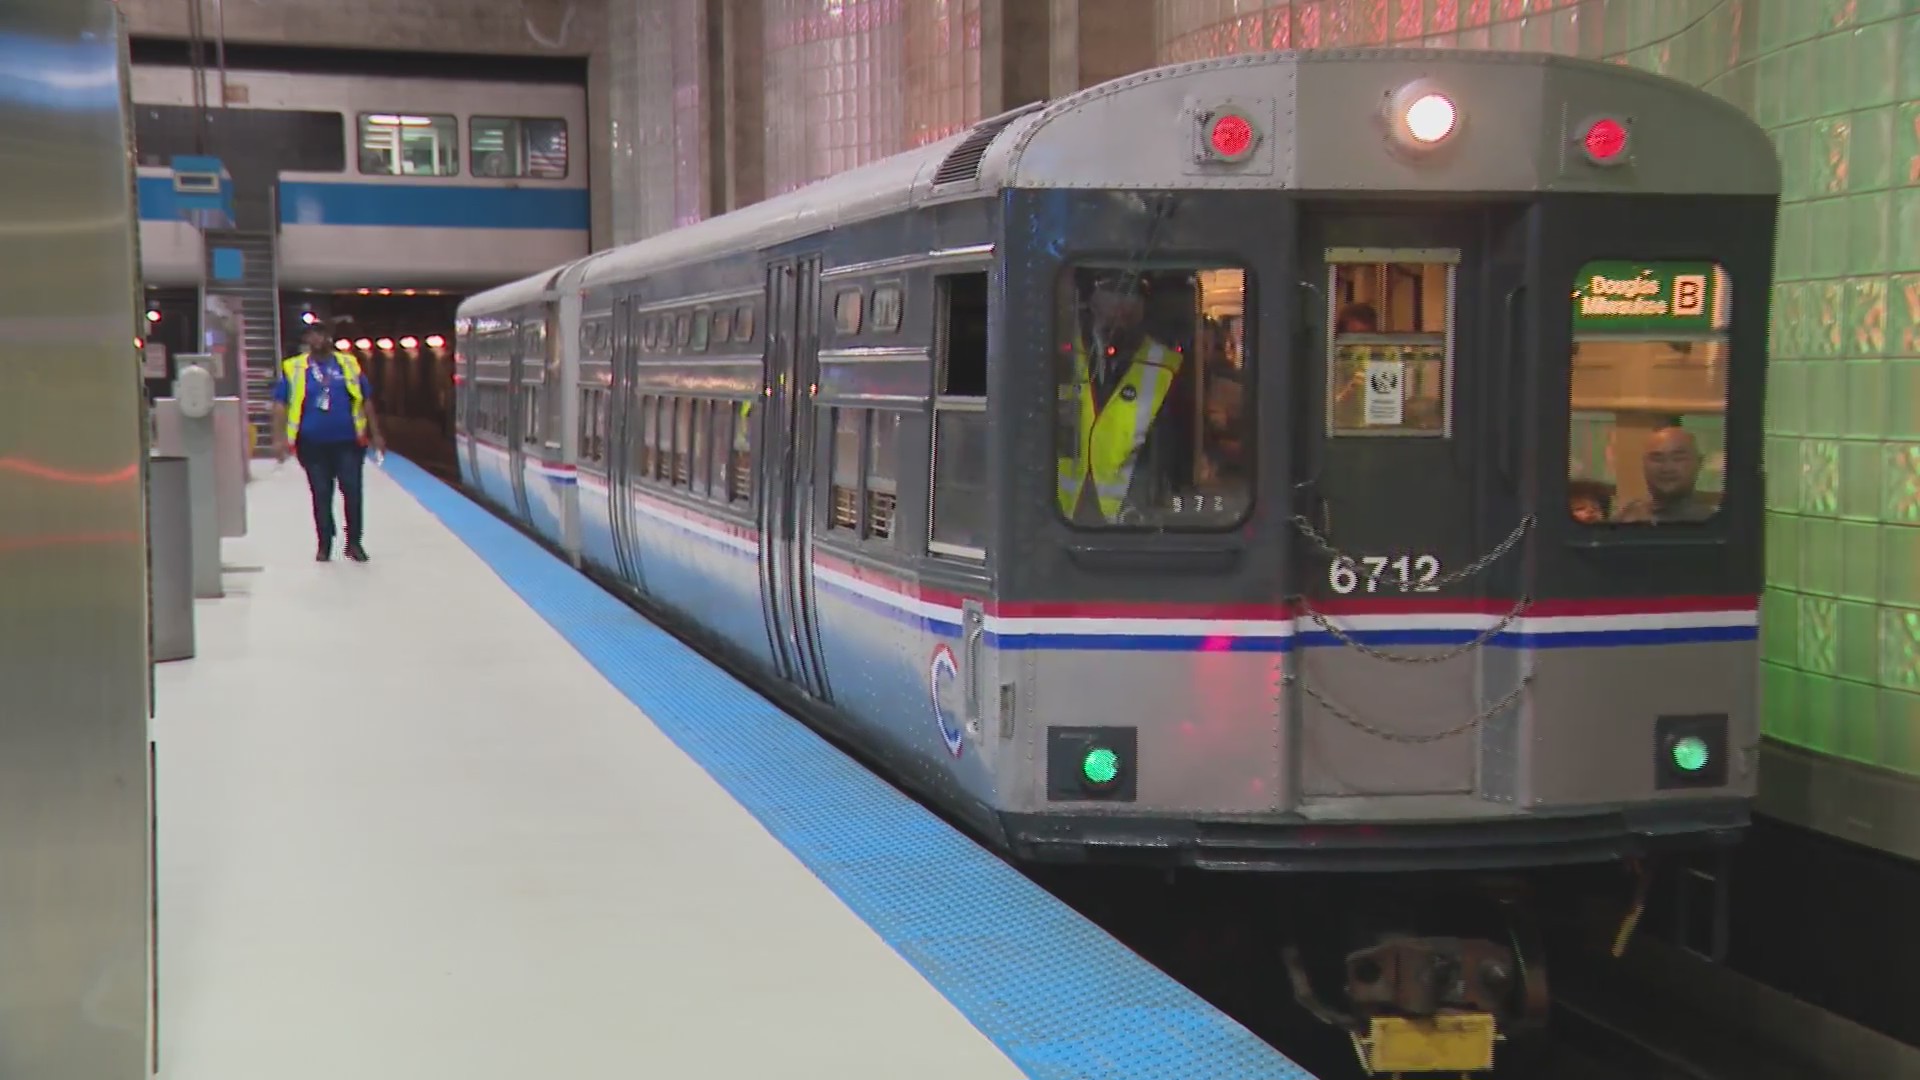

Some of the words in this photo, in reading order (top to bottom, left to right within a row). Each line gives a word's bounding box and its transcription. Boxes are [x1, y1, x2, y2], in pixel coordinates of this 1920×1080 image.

[1592, 276, 1660, 297] Douglas
[1679, 281, 1699, 308] B
[1329, 556, 1441, 594] 6712
